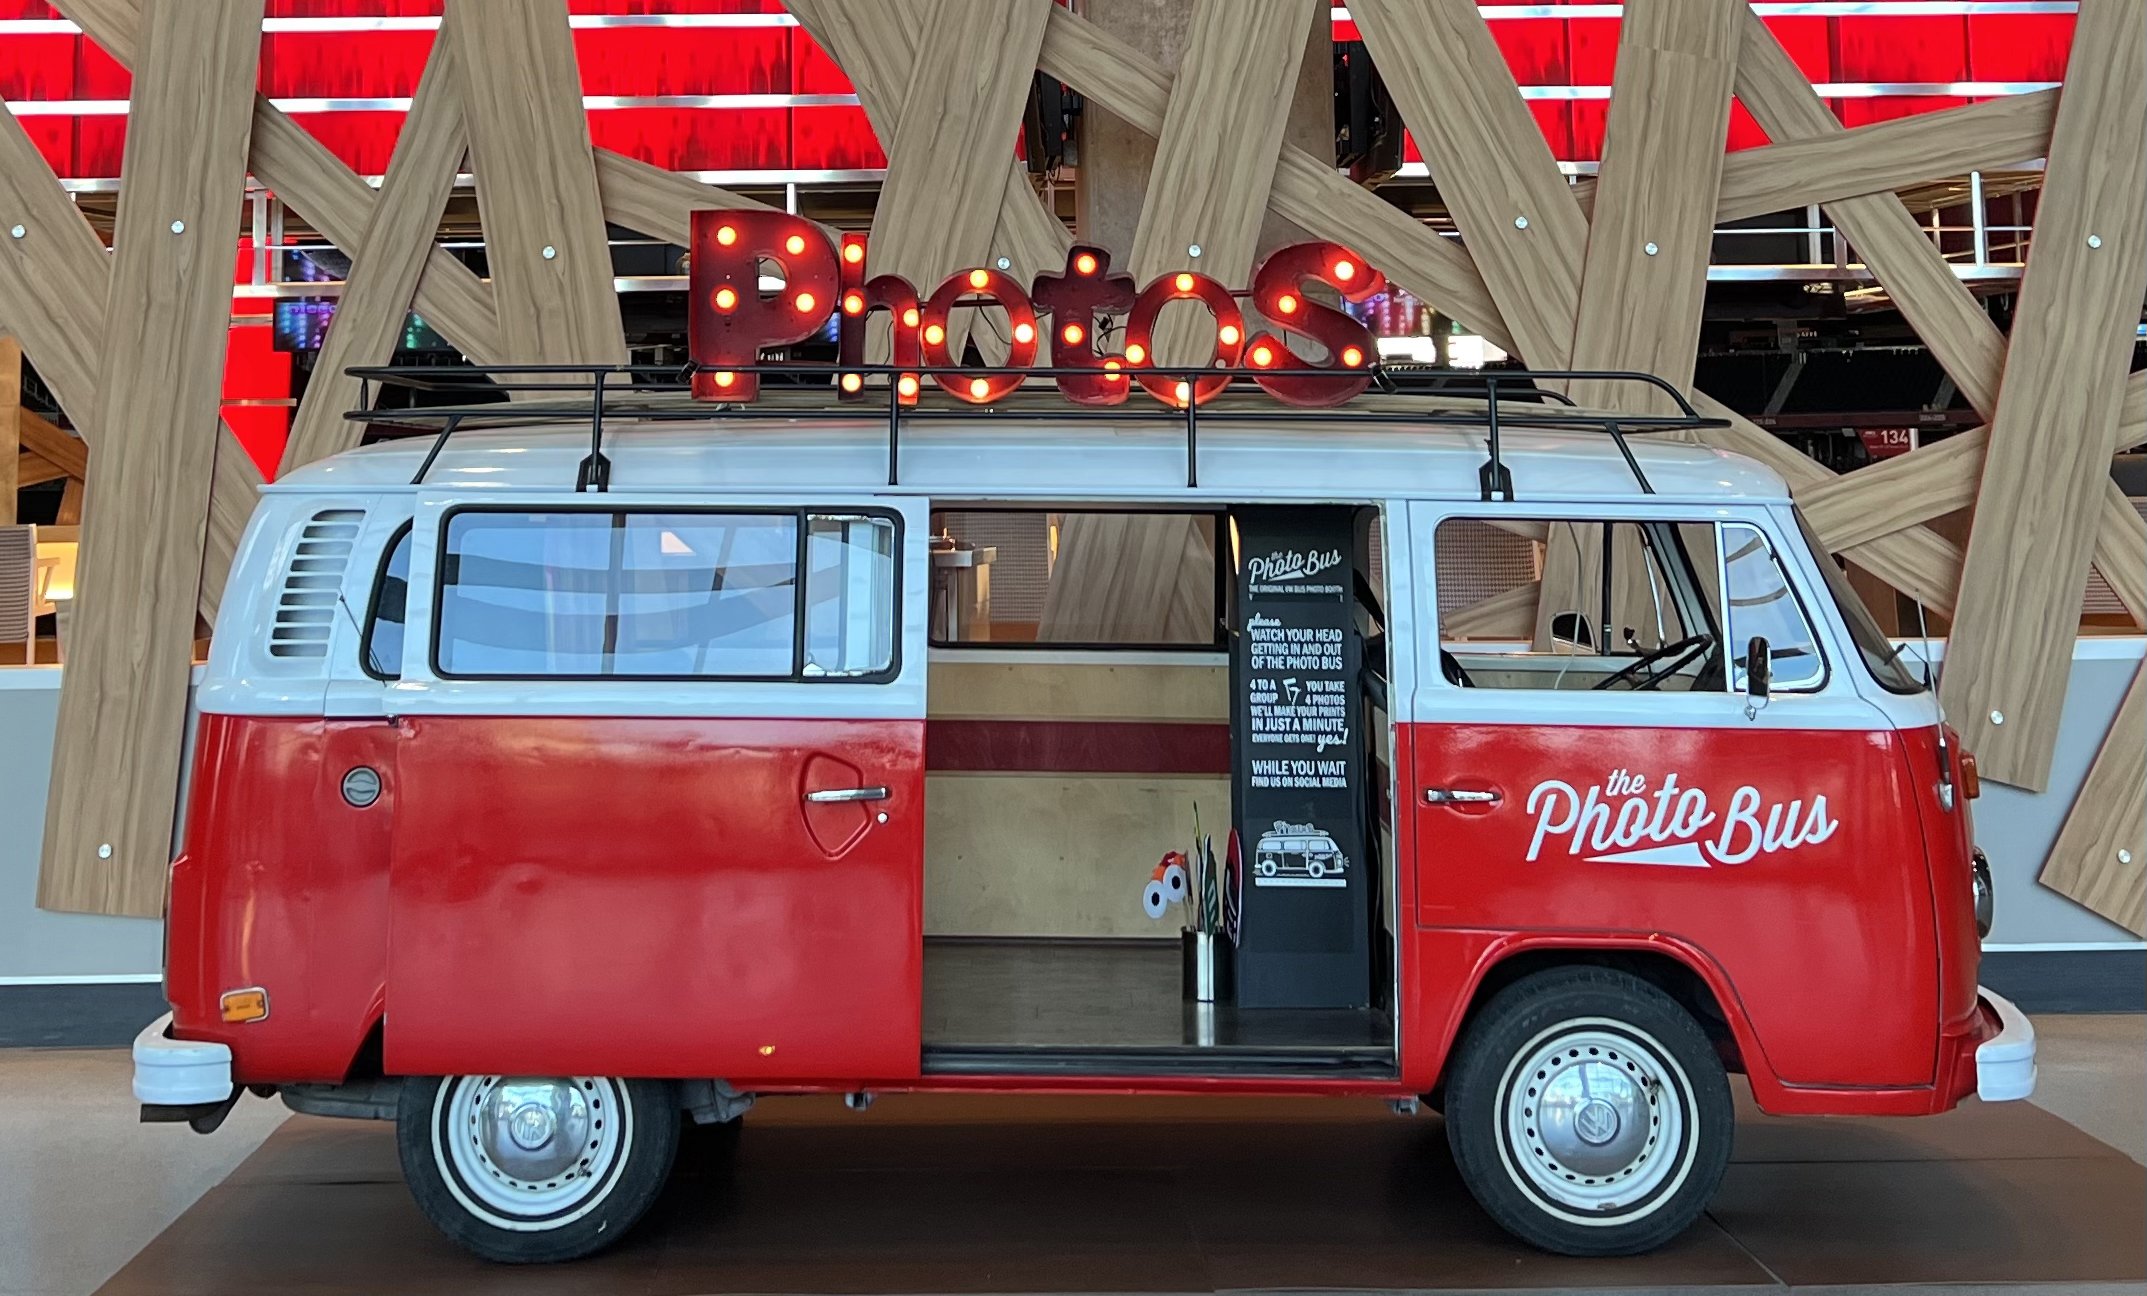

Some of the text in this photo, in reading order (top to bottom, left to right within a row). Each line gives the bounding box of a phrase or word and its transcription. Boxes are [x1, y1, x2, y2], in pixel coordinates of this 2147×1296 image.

[1881, 430, 1909, 444] 134
[1248, 549, 1342, 584] Photo Bus
[1247, 612, 1281, 631] please
[1251, 629, 1342, 642] WATCH YOUR HEAD
[1251, 643, 1342, 655] GETTING IN AND OUT
[1251, 656, 1343, 670] OF THE PHOTO BUS
[1249, 678, 1277, 690] 4 TO A
[1305, 680, 1345, 692] YOU TAKE
[1250, 692, 1278, 703] GROUP
[1305, 694, 1346, 705] 4 PHOTOS
[1250, 705, 1346, 717] WE'LL MAKE YOUR PRINTS
[1251, 717, 1345, 732] IN JUST A MINUTE
[1252, 733, 1283, 743] EVERYONE
[1284, 733, 1300, 743] GETS
[1316, 728, 1349, 753] yes!
[1252, 760, 1346, 775] WHILE YOU WAIT
[1252, 776, 1347, 788] FIND US ON SOCIAL MEDIA
[1605, 768, 1646, 796] the
[1526, 772, 1838, 864] Photo Bus
